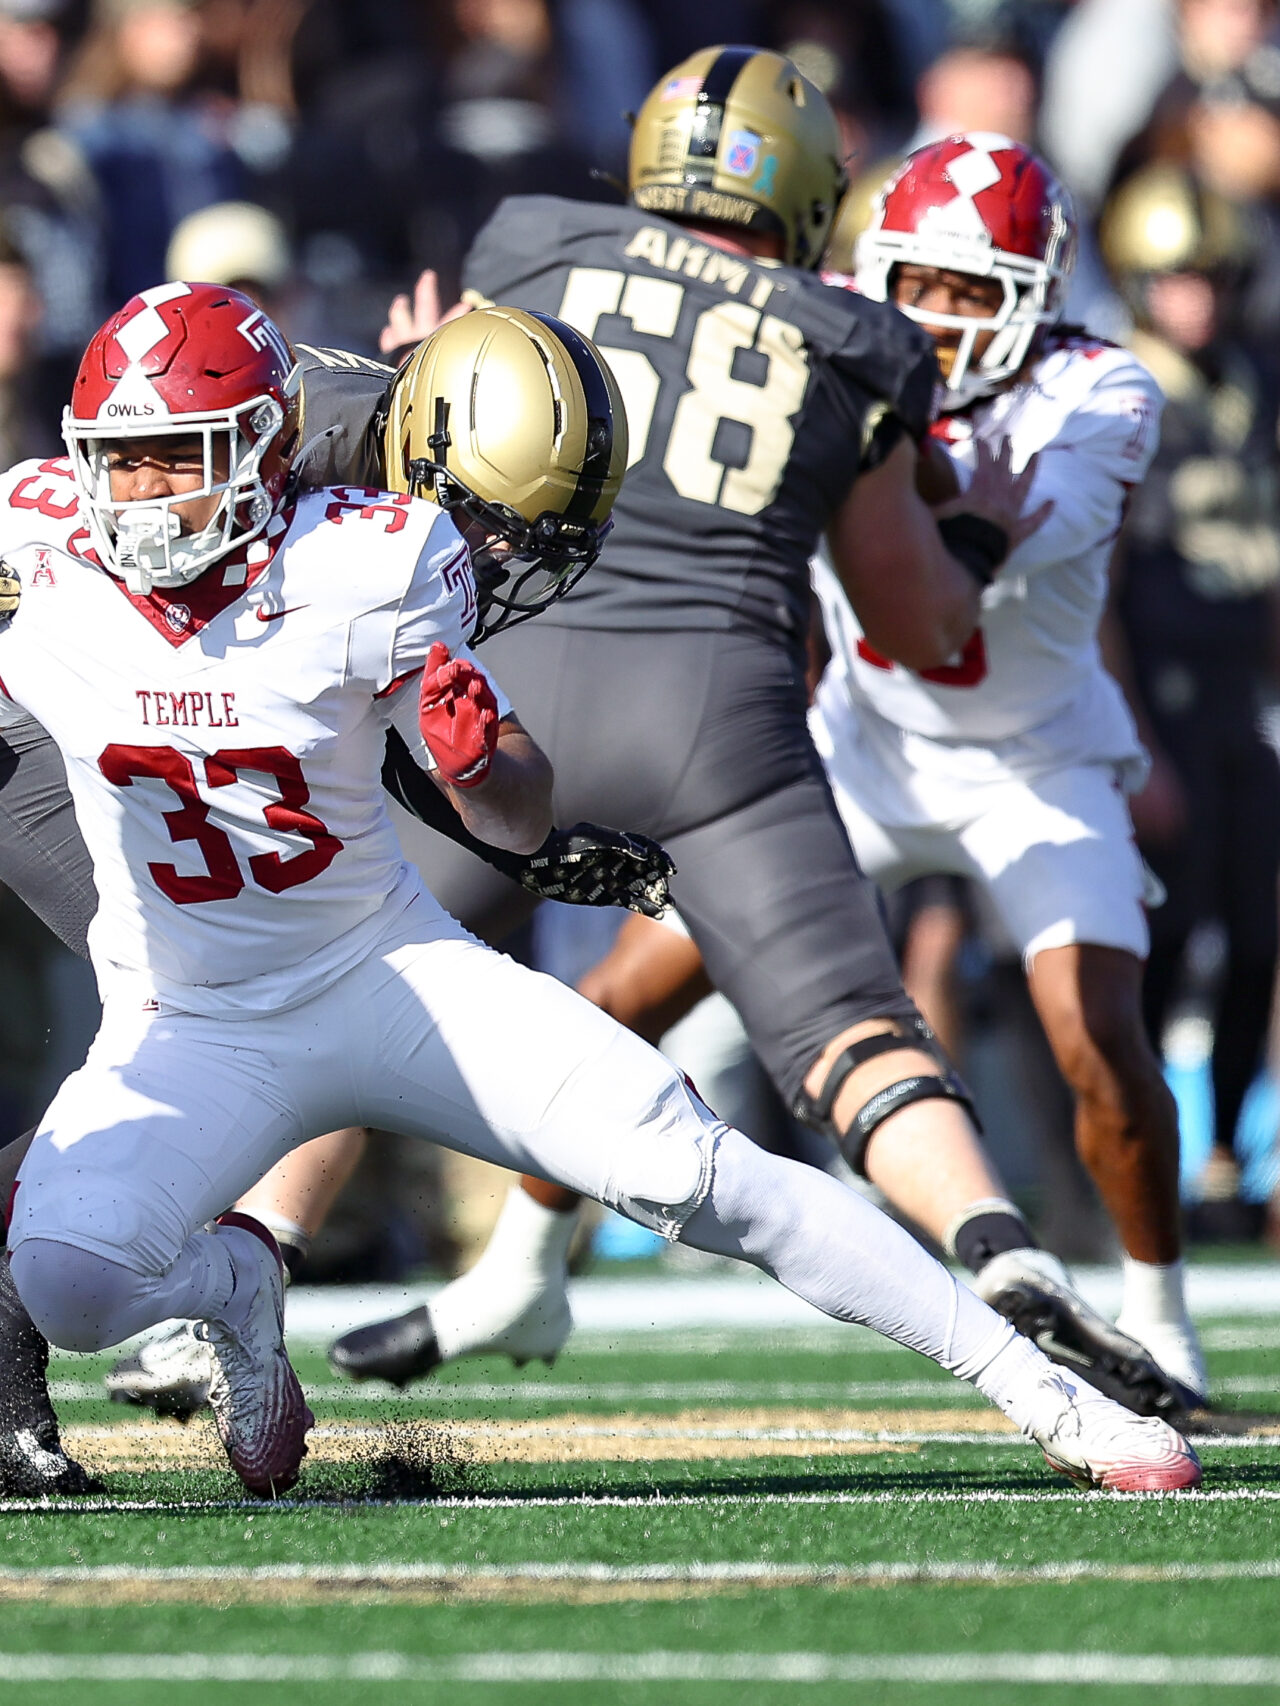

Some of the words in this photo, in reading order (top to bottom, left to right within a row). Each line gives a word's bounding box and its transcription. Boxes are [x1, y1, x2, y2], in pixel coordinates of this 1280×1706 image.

[107, 403, 155, 417] OWLS
[558, 267, 811, 516] 58
[136, 690, 239, 727] TEMPLE
[97, 743, 345, 905] 33
